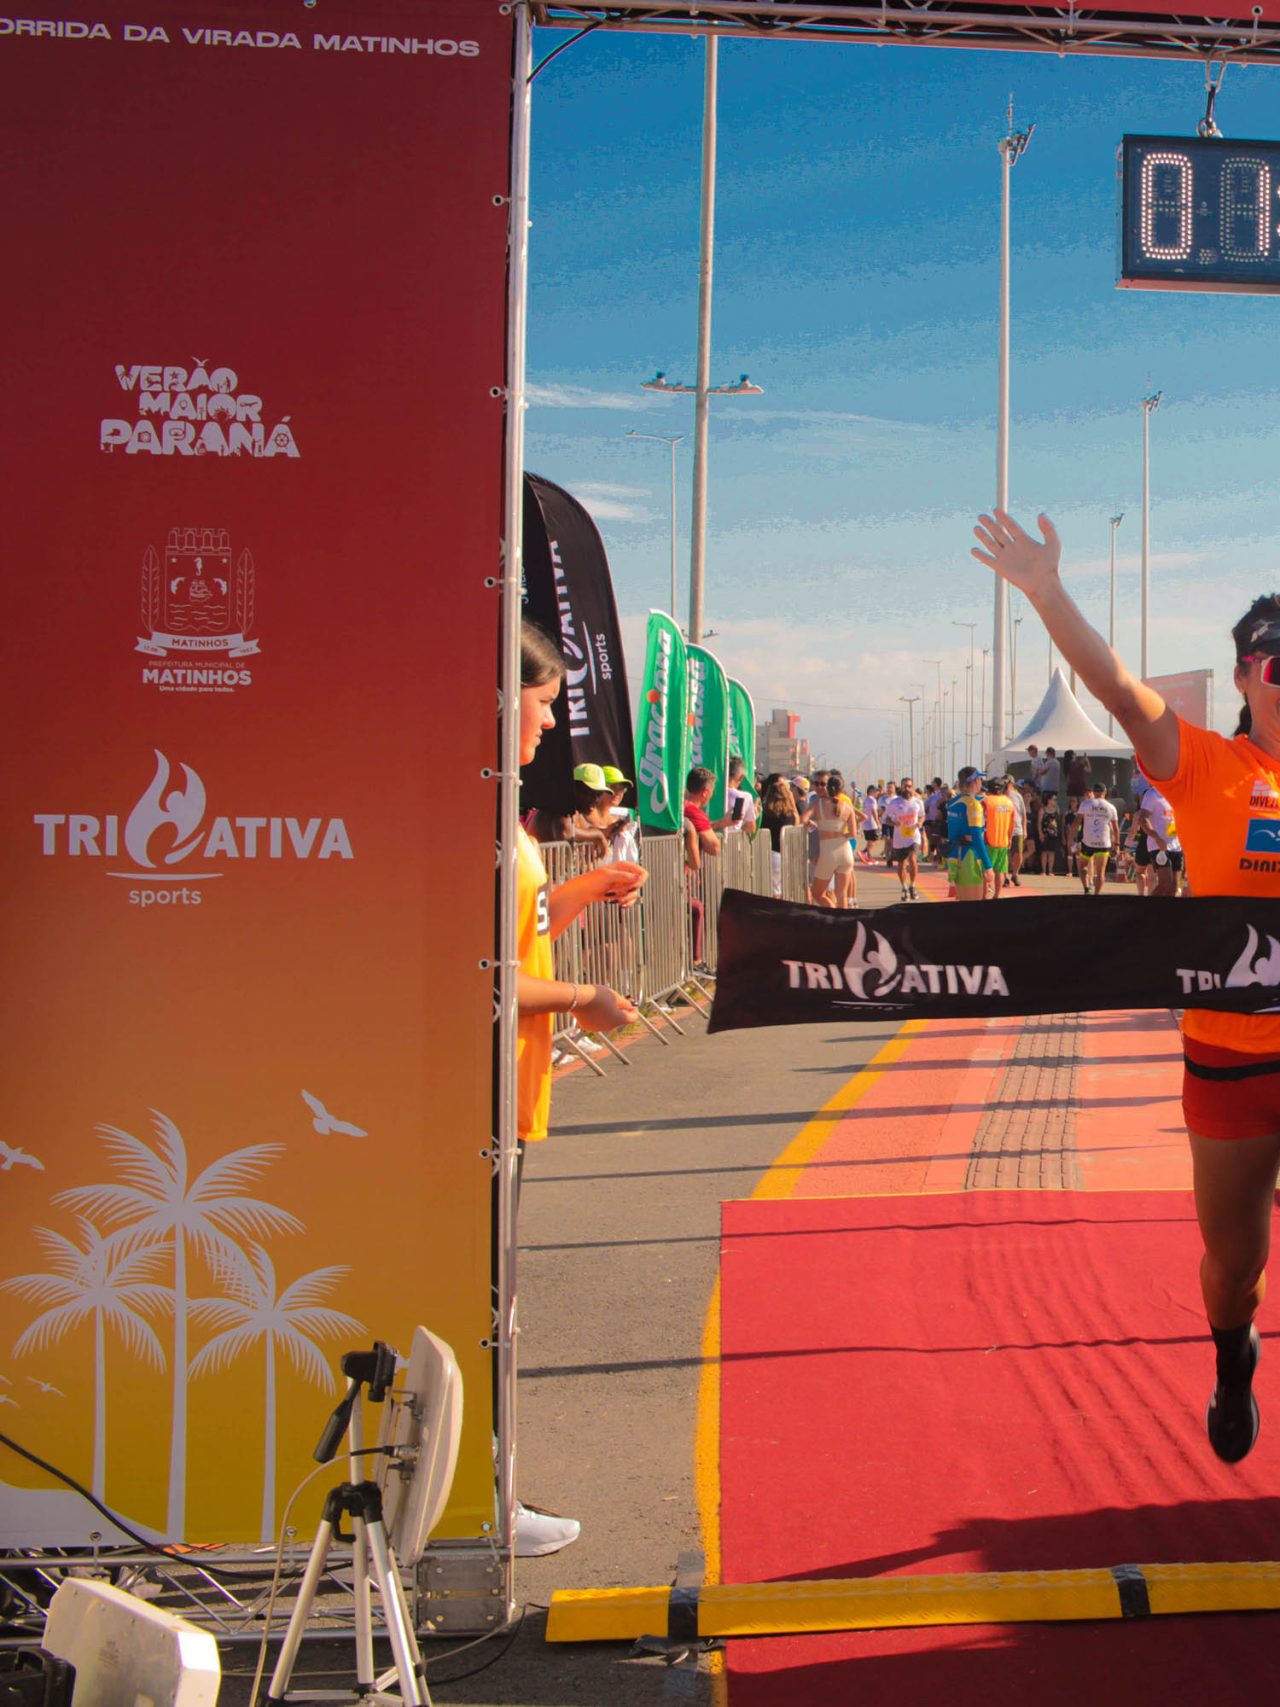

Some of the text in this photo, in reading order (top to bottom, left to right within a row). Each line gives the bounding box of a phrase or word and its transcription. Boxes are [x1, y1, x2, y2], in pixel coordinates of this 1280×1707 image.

[123, 25, 170, 44] DA
[182, 28, 302, 50] VIRADA
[313, 33, 480, 57] MATINHOS
[115, 357, 238, 392] VERÃO
[139, 392, 262, 422] MAIOR
[101, 416, 300, 457] PARANÁ
[171, 638, 229, 648] MATINHOS
[142, 668, 252, 685] MATINHOS
[34, 813, 354, 860] TRI ATIVA
[129, 886, 202, 909] sports
[782, 960, 1009, 997] TRI ATIVA
